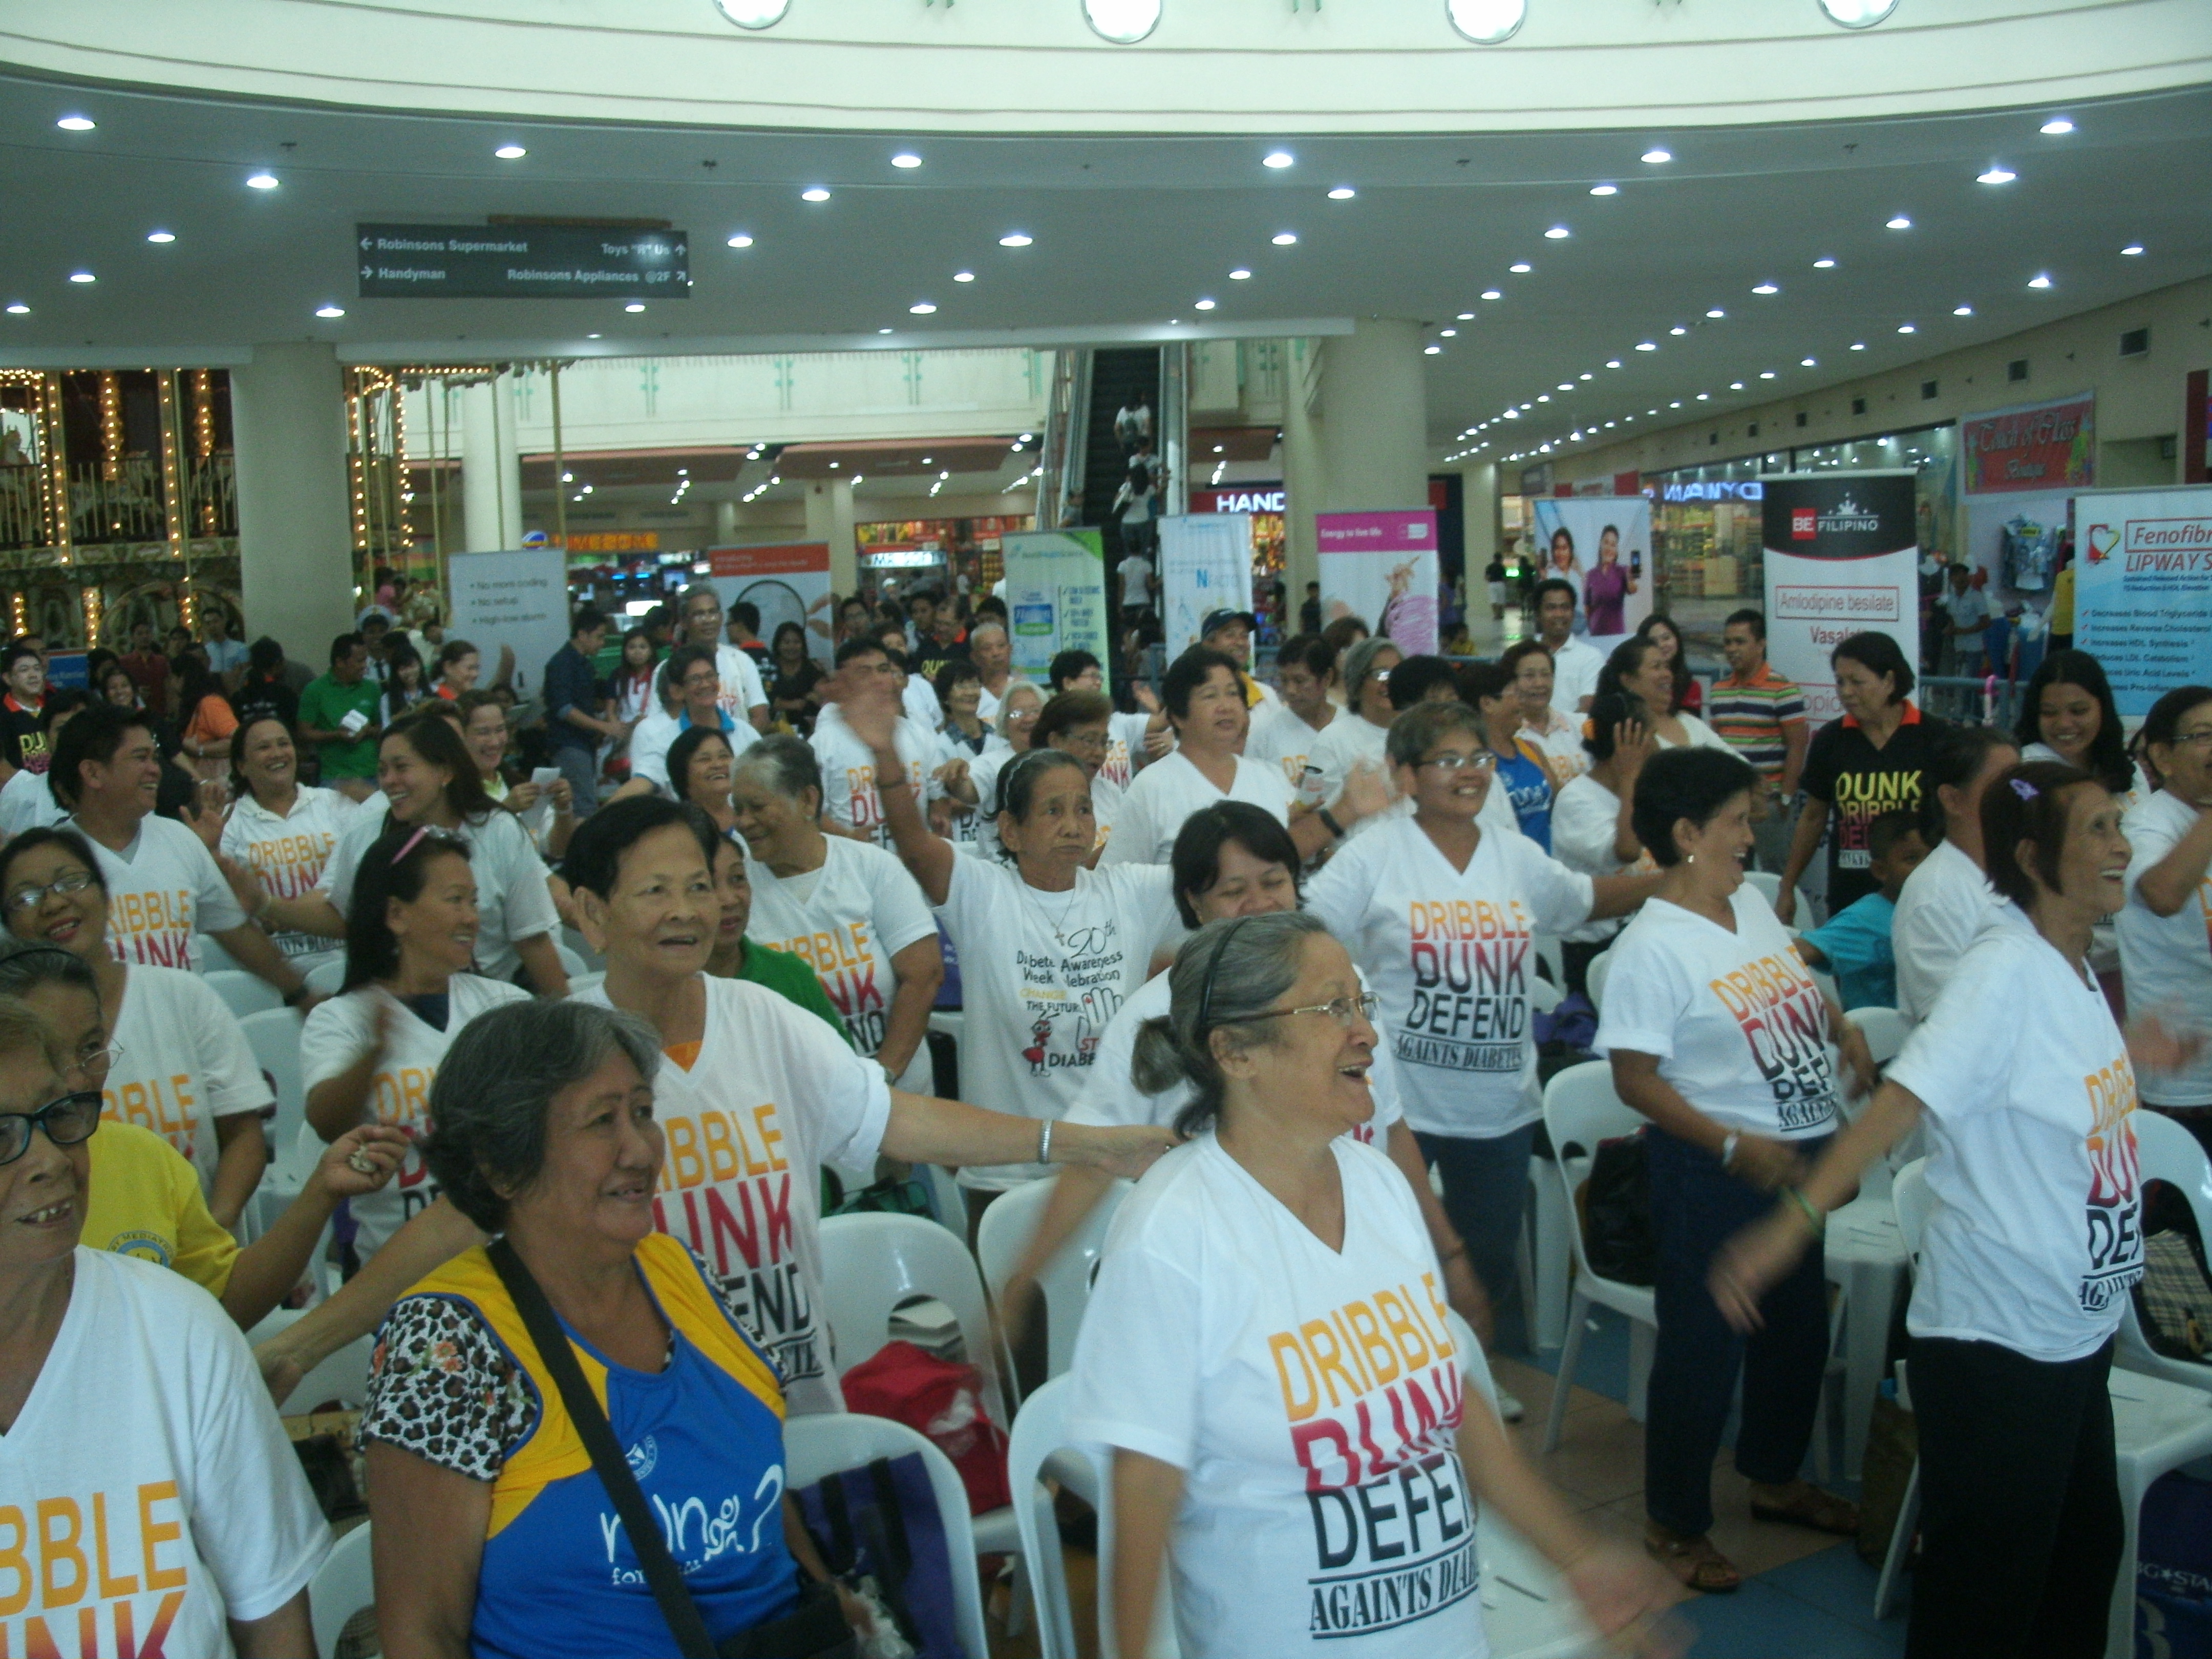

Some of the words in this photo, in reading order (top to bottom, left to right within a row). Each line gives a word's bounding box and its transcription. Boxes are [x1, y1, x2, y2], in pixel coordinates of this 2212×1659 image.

[377, 239, 444, 252] Robinsons
[449, 240, 528, 253] Supermarket
[601, 243, 629, 256] Toys
[378, 268, 446, 280] Handyman
[507, 269, 571, 282] Robinsons
[574, 269, 639, 284] Appliances
[1792, 516, 1814, 531] BE
[1818, 520, 1879, 531] FILIPINO
[2126, 553, 2200, 572] LIPWAY
[1781, 592, 1844, 614] Amlodipine
[1835, 770, 1922, 802] DUNK
[1411, 900, 1530, 940] DRIBBLE
[1411, 940, 1530, 995] DUNK
[1406, 989, 1526, 1039] DEFEND
[1267, 1271, 1459, 1422] DRIBBLE
[1309, 1564, 1433, 1632] AGAINTS
